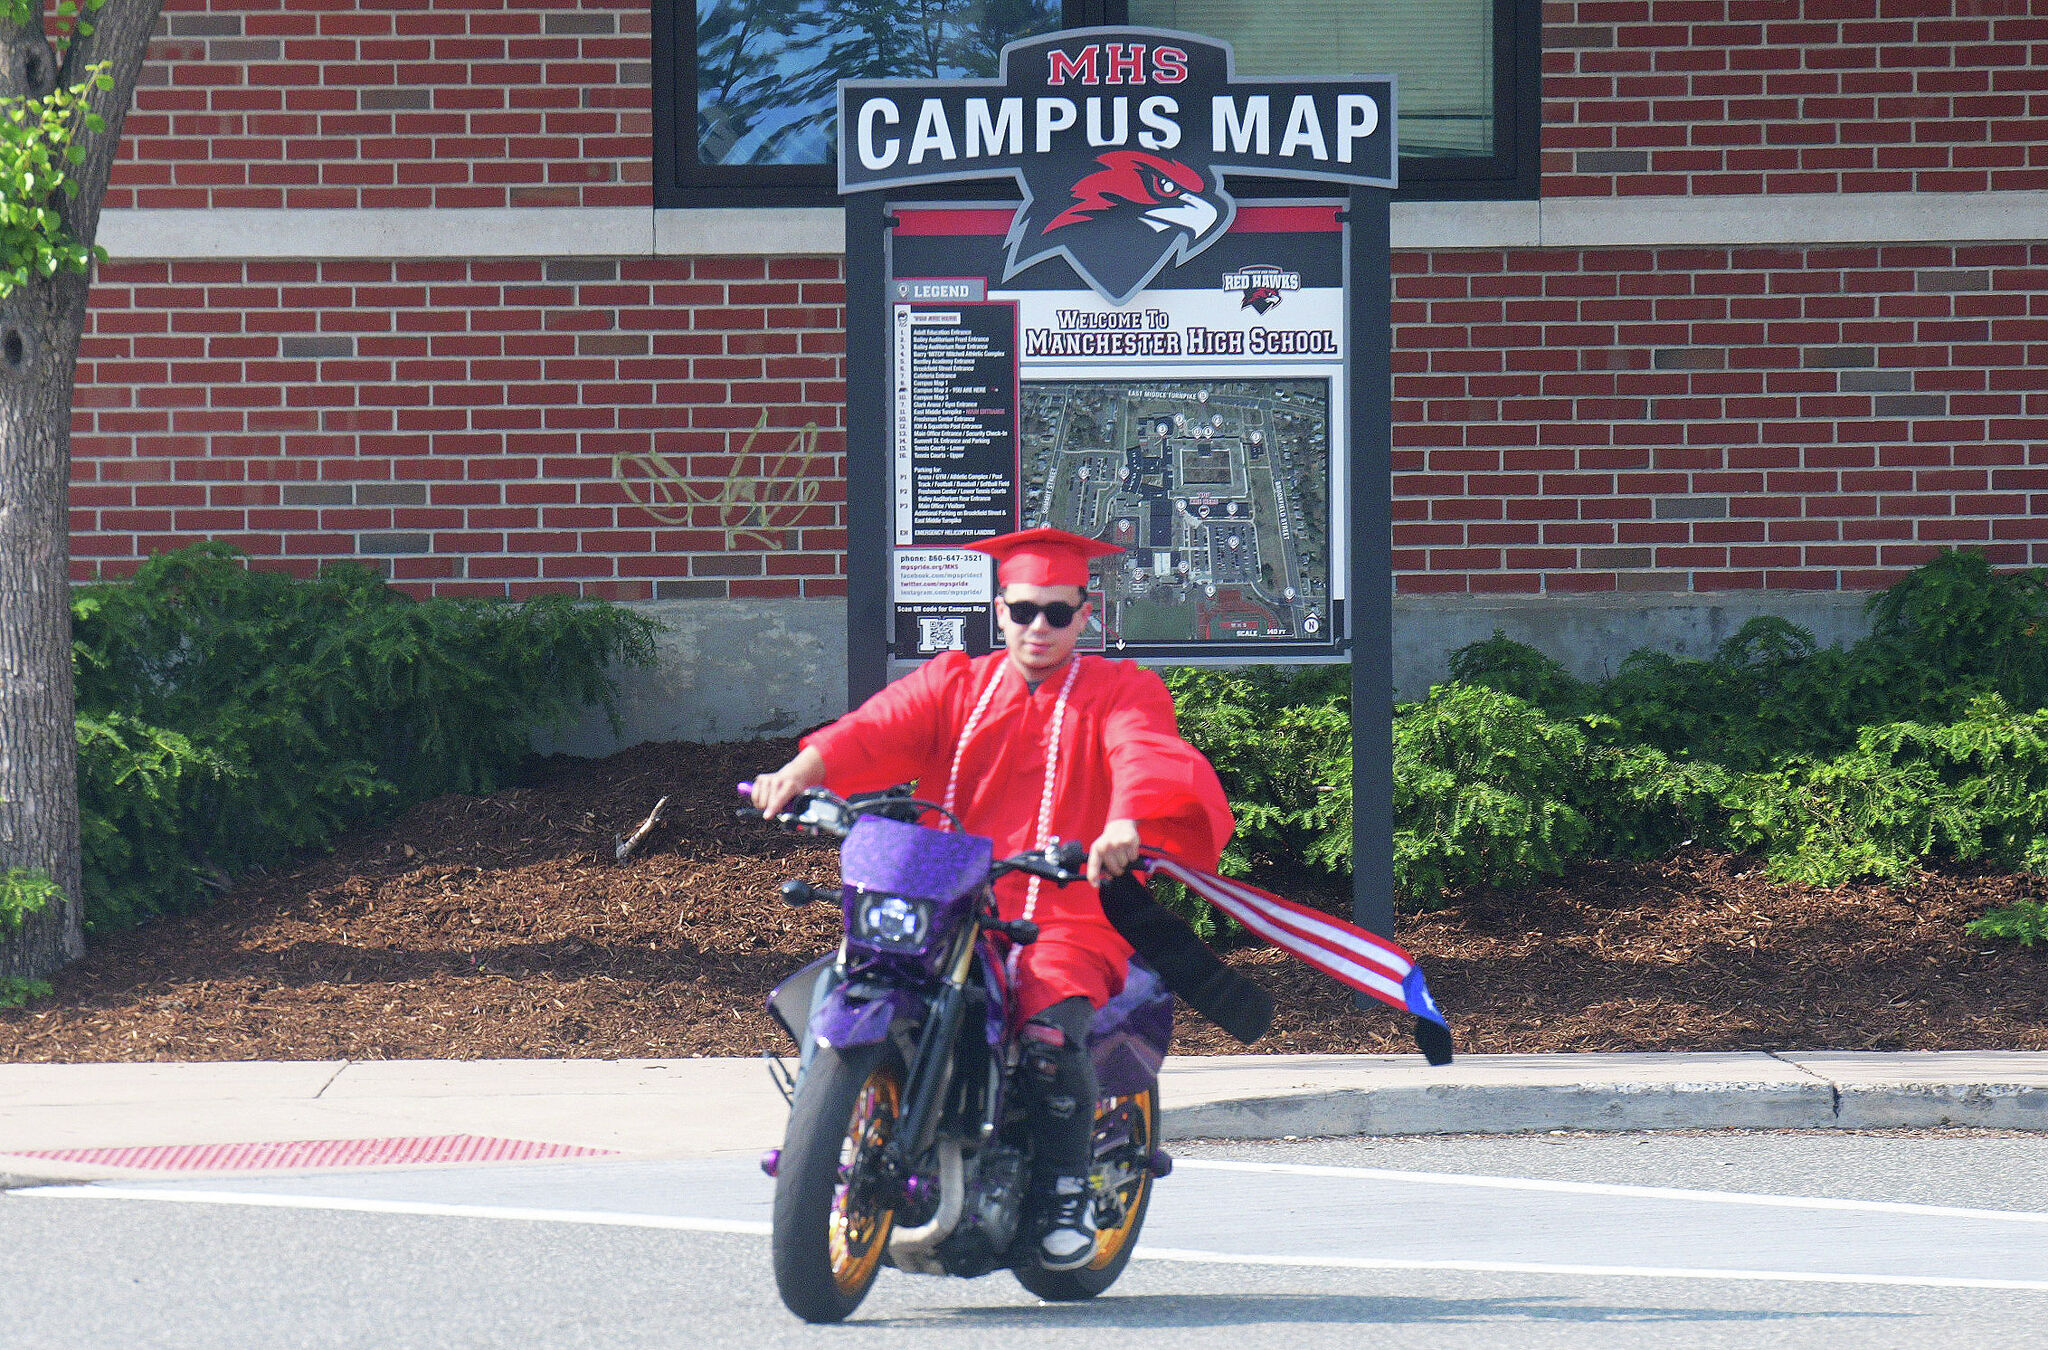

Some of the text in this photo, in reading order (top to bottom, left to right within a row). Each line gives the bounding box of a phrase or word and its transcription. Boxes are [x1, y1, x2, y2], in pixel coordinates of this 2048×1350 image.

[1047, 44, 1188, 85] MHS
[857, 94, 1378, 170] CAMPUS MAP
[1224, 274, 1299, 291] RED HAWKS
[914, 285, 969, 298] LEGEND
[1025, 326, 1338, 356] MANCHESTER HIGH SCHOOL
[1127, 389, 1142, 397] EAST
[900, 555, 926, 563] phone:
[948, 605, 972, 613] Campus
